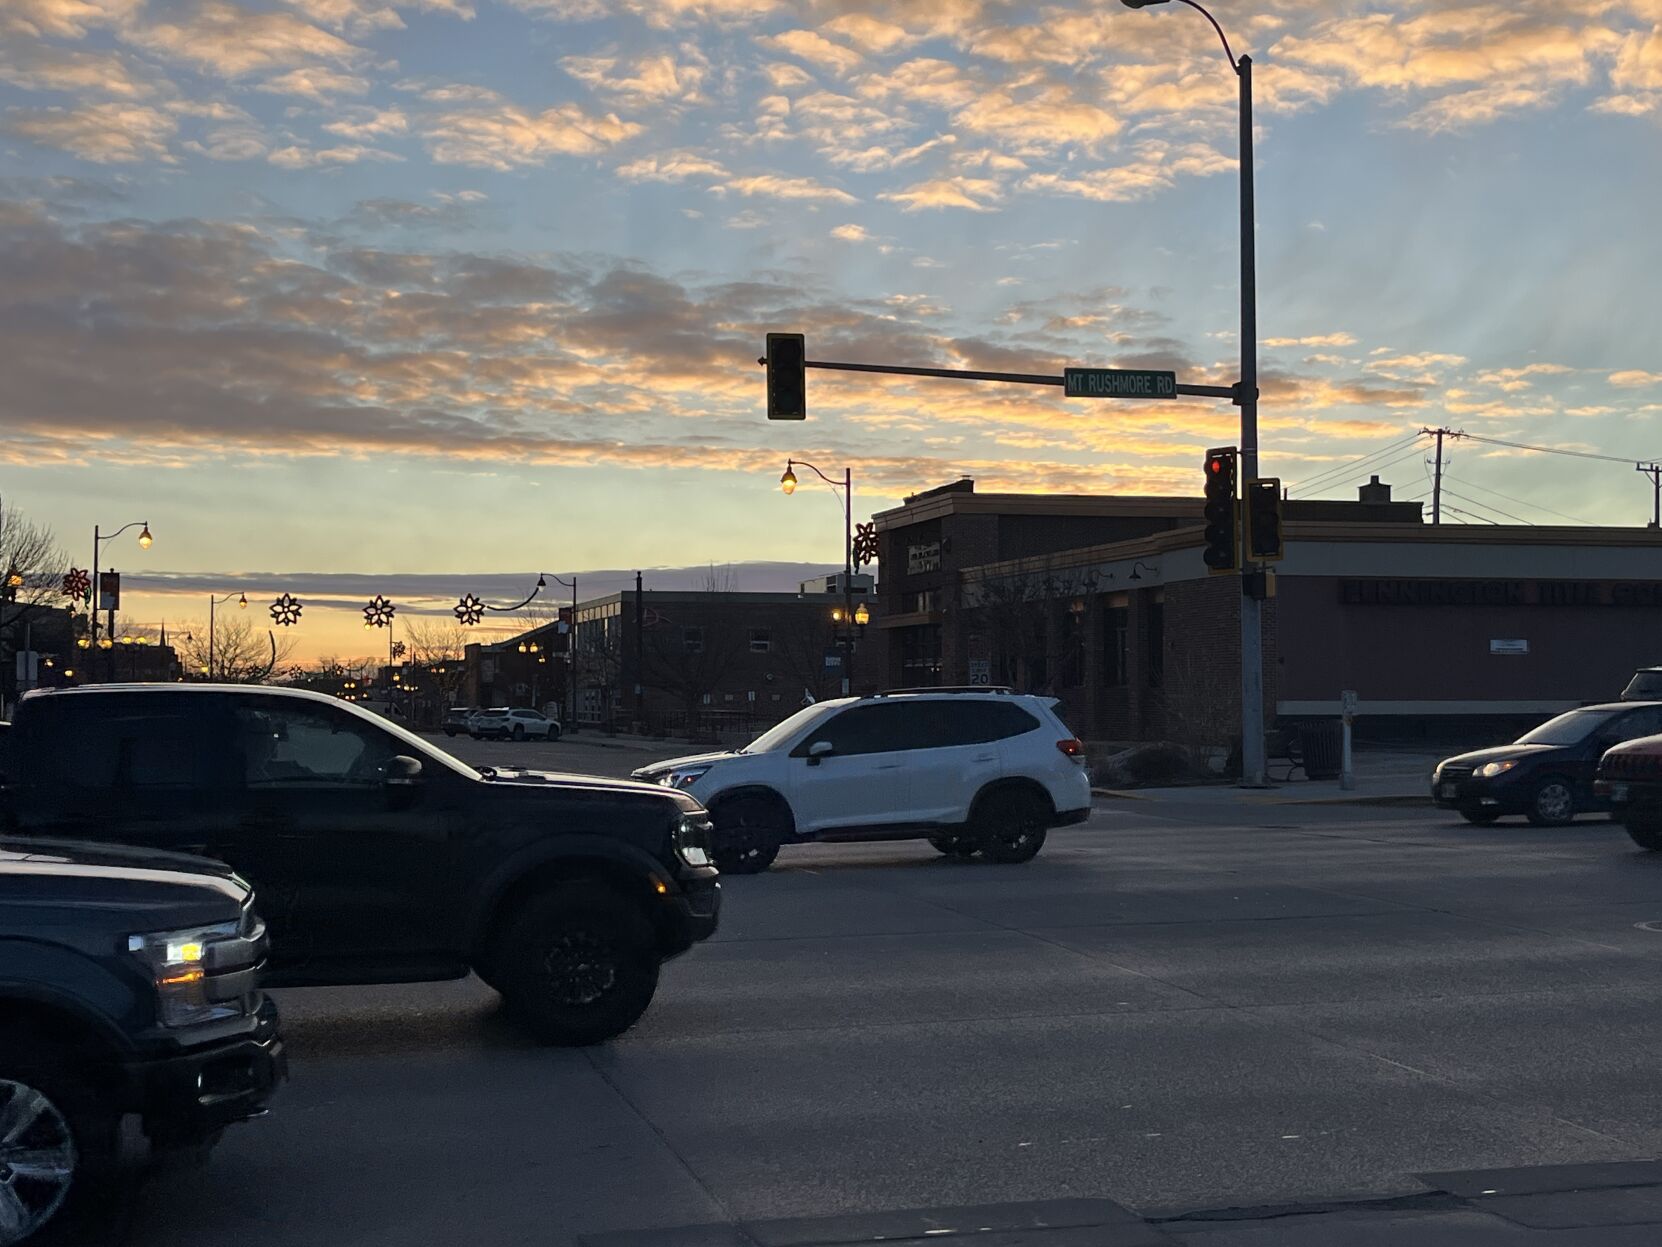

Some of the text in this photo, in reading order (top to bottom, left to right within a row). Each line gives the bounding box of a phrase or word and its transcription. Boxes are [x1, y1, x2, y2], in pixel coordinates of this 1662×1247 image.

[1068, 373, 1173, 394] MT RUSHMORE RD
[971, 673, 989, 685] 20
